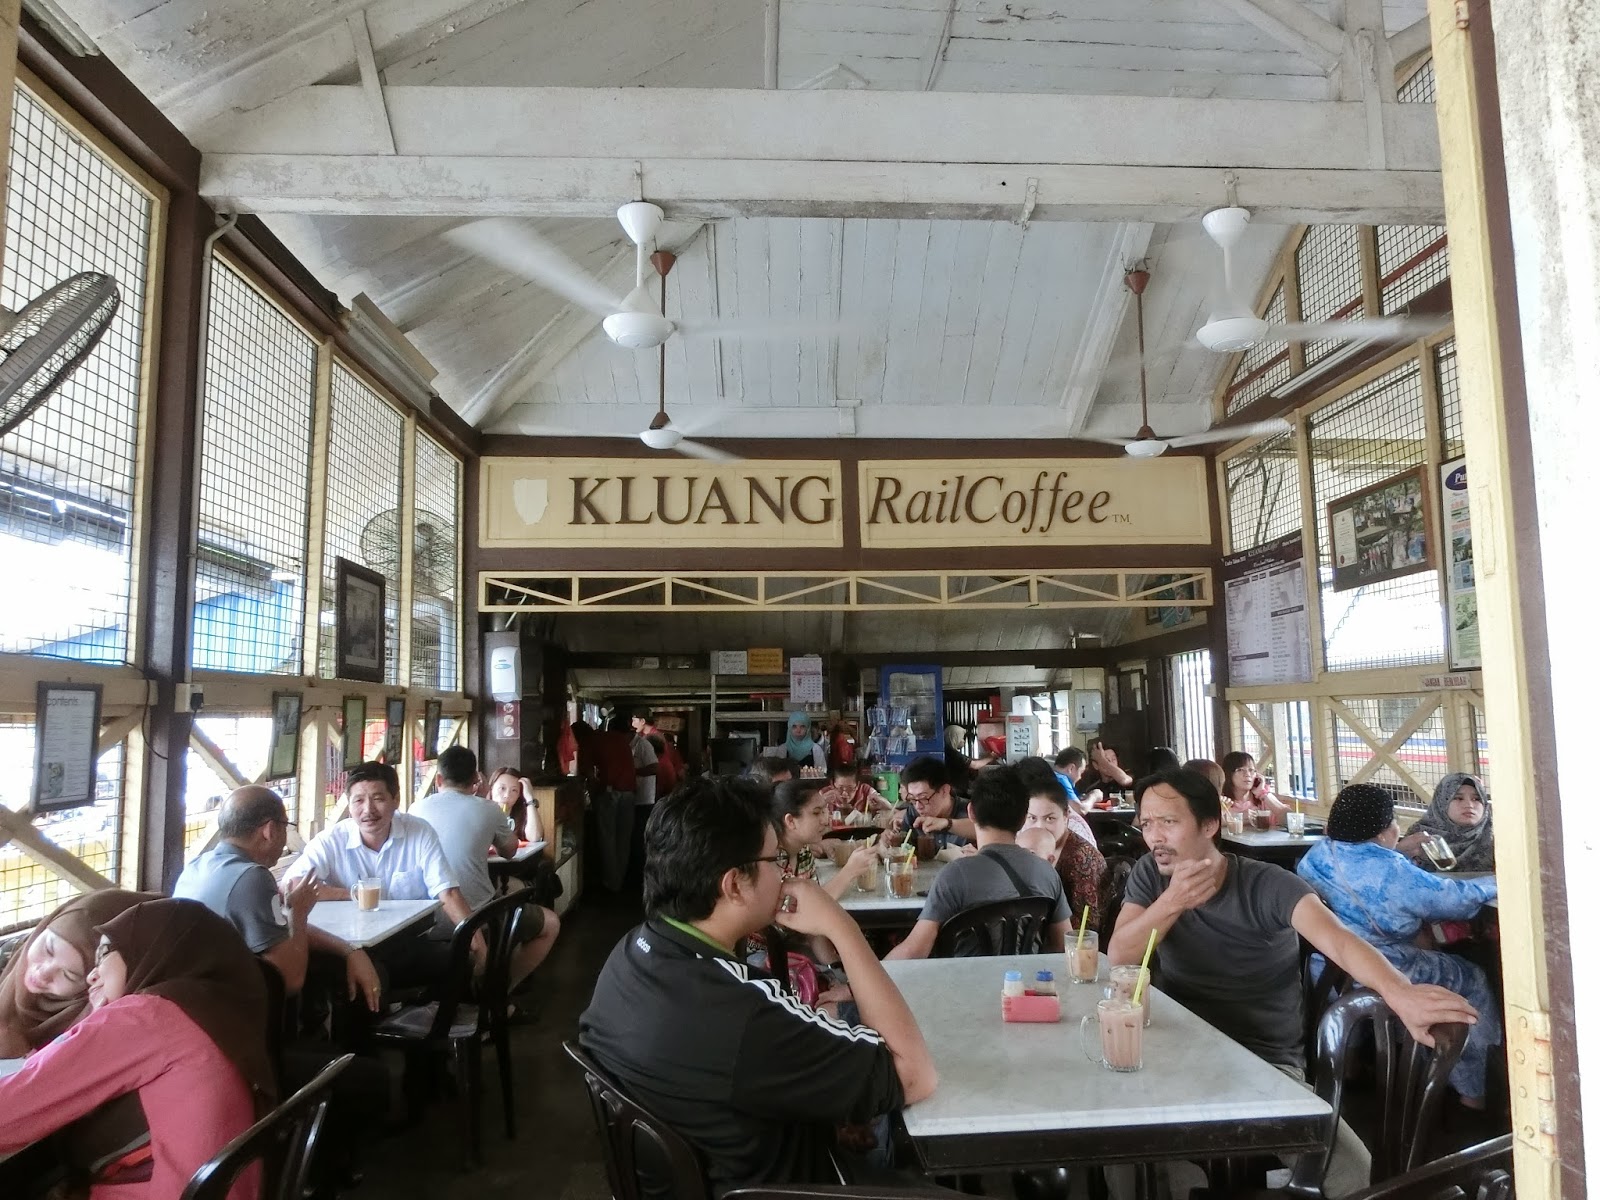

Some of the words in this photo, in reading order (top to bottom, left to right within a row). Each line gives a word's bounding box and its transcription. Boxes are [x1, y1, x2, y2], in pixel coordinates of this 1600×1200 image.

[567, 476, 836, 526] KLUANG
[866, 470, 1111, 534] RailCoffee
[1112, 514, 1130, 523] TM
